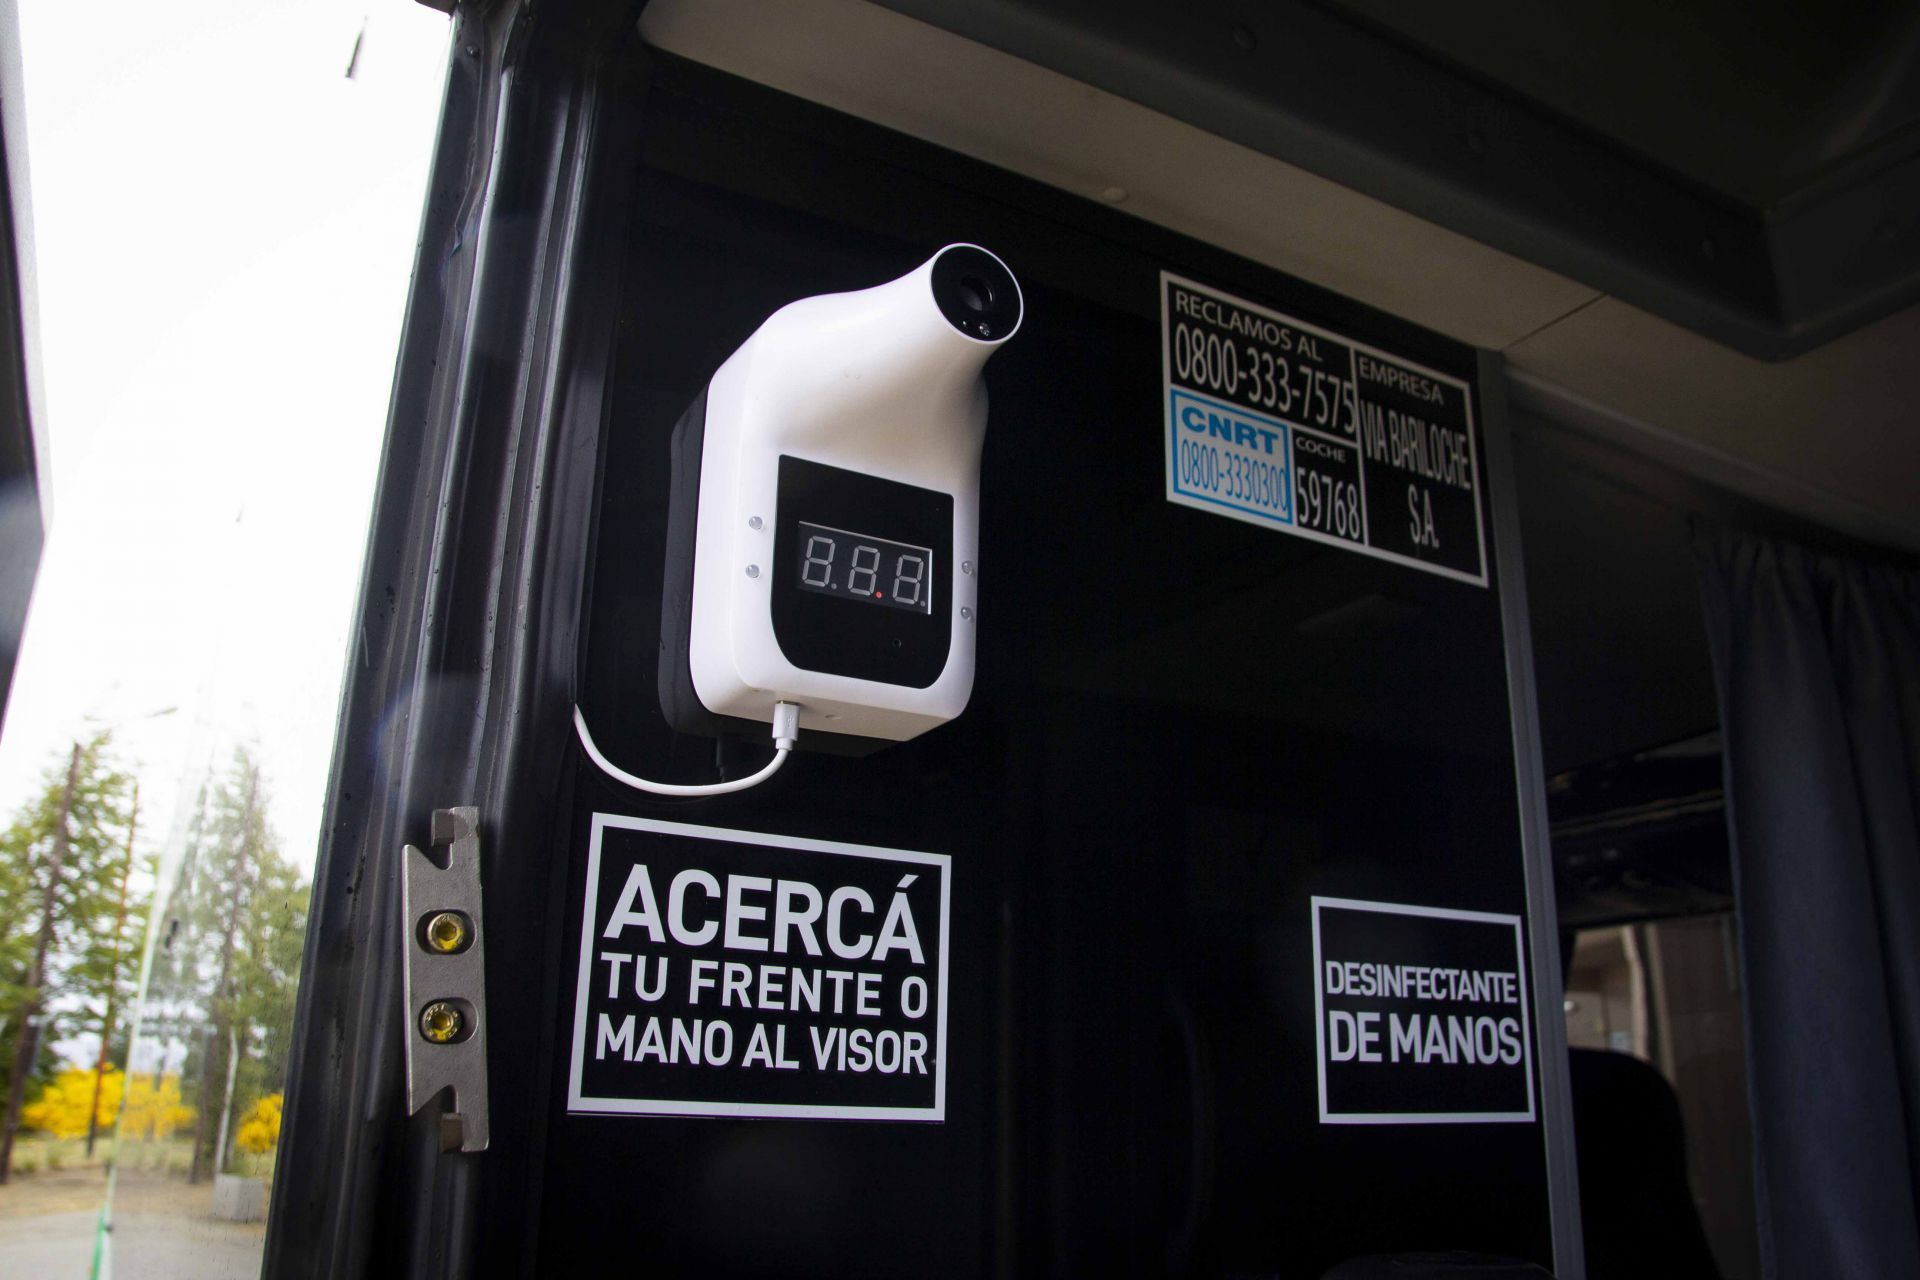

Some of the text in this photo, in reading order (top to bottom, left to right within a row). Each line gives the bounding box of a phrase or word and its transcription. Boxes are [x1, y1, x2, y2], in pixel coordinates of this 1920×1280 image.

[1175, 289, 1324, 362] RECLAMOS AL
[1175, 322, 1356, 435] 0800-333-7575
[1358, 357, 1445, 405] EMPRESA
[1181, 406, 1279, 455] CNRT
[1296, 435, 1347, 464] COCHE
[1360, 399, 1472, 490] VIA BARILOCHE
[1181, 438, 1289, 512] 0800-3330300
[1297, 466, 1361, 540] 59768
[602, 863, 926, 965] ACERCÁ
[600, 951, 928, 1019] TU FRENTE O
[1325, 960, 1518, 1004] DESINFECTANTE
[595, 1012, 928, 1075] MANO AL VISOR
[1328, 1010, 1522, 1066] DE MANOS
